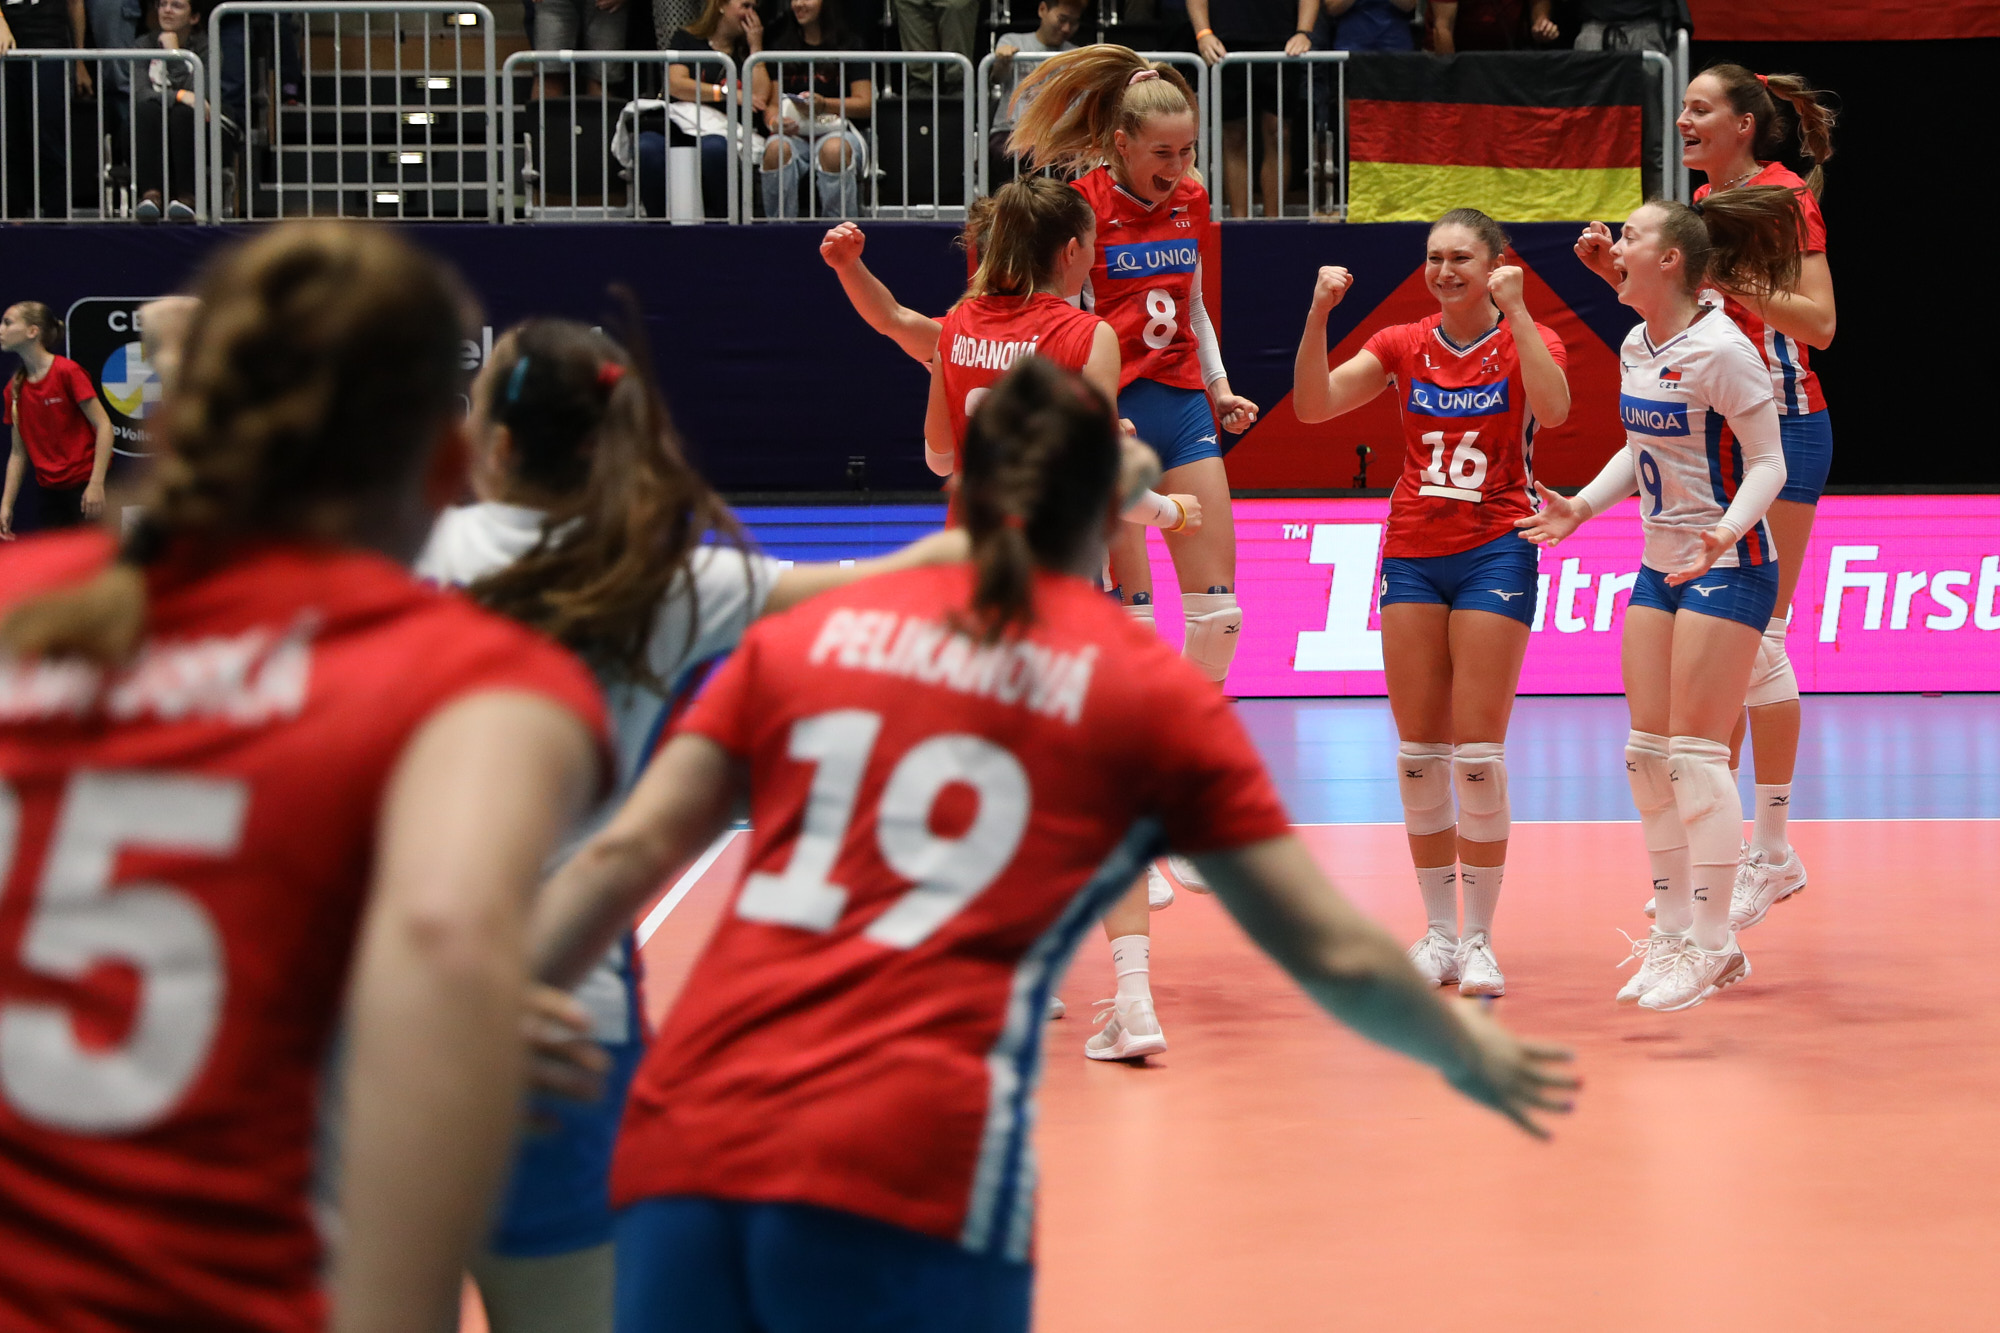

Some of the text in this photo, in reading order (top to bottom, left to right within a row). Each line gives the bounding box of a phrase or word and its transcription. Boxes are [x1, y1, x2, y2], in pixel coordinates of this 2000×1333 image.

[1145, 247, 1197, 269] UNIQA
[107, 310, 145, 332] CE
[1142, 288, 1178, 350] 8
[1659, 381, 1679, 390] CZE
[1438, 390, 1504, 410] UNIQA
[1626, 405, 1682, 430] UNIQA
[1419, 430, 1488, 490] 16
[1639, 449, 1663, 517] 9
[1282, 524, 1308, 540] TM
[735, 706, 1033, 953] 19
[0, 766, 254, 1136] 5
